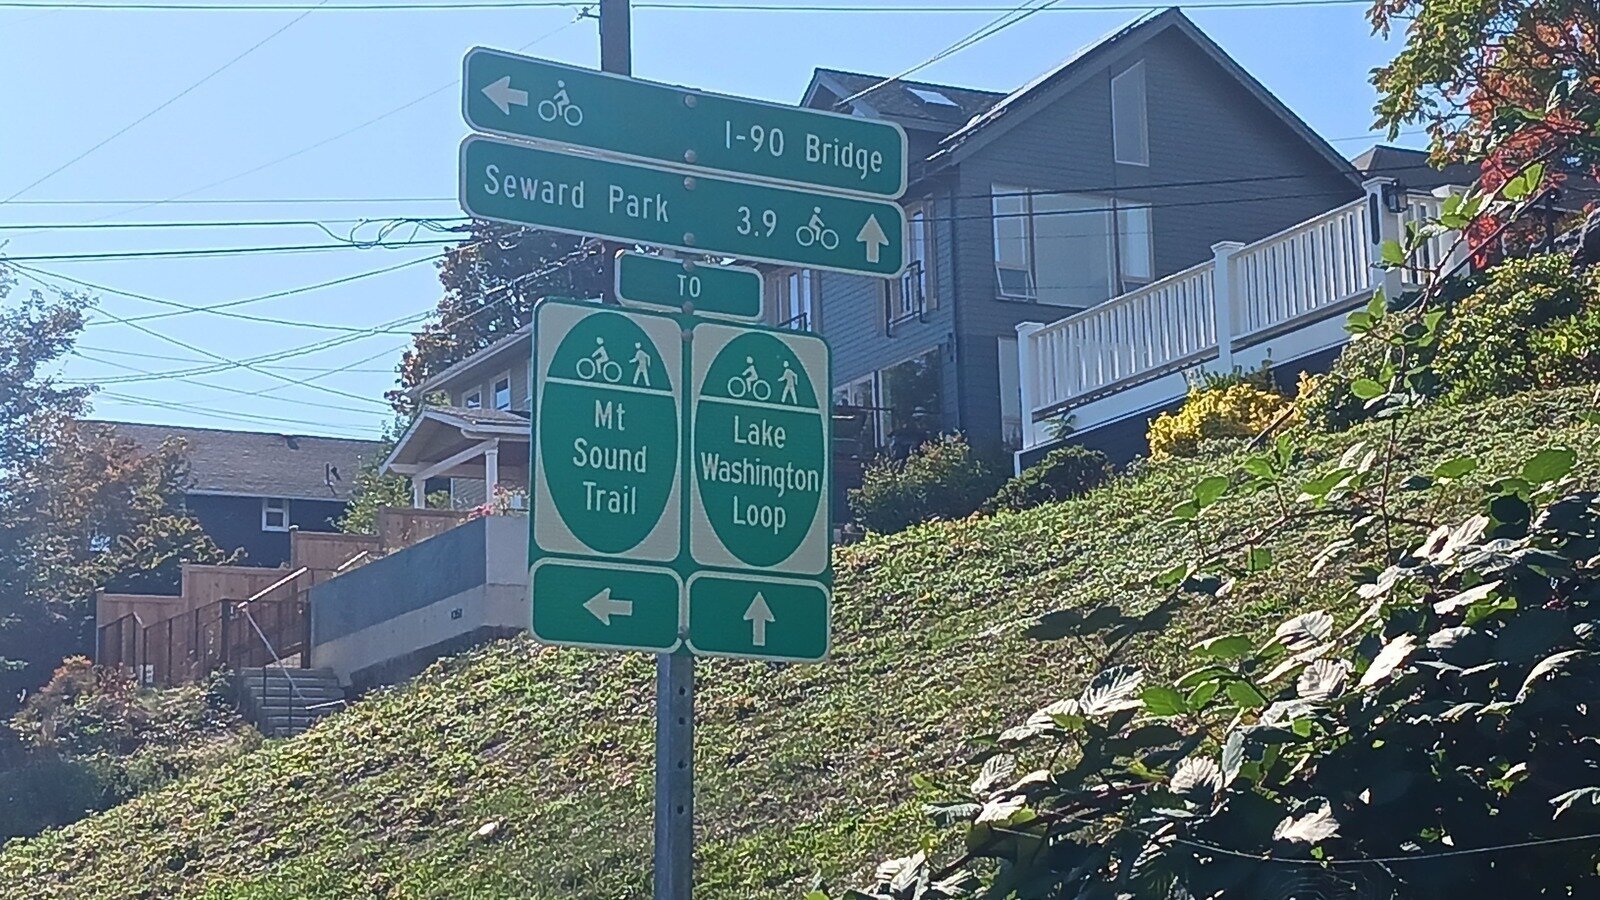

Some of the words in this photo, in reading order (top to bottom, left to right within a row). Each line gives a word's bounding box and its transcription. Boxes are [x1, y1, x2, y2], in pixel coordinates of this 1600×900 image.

[724, 120, 785, 157] I-90
[804, 134, 884, 180] Bridge
[483, 164, 585, 209] Seward
[608, 184, 669, 223] Park
[736, 206, 777, 238] 3.9
[677, 274, 701, 298] TO
[594, 400, 625, 431] Mt
[733, 415, 787, 449] Lake
[572, 438, 647, 473] Sound
[700, 452, 820, 498] Washington
[583, 481, 637, 515] Trail
[732, 495, 787, 535] Loop
